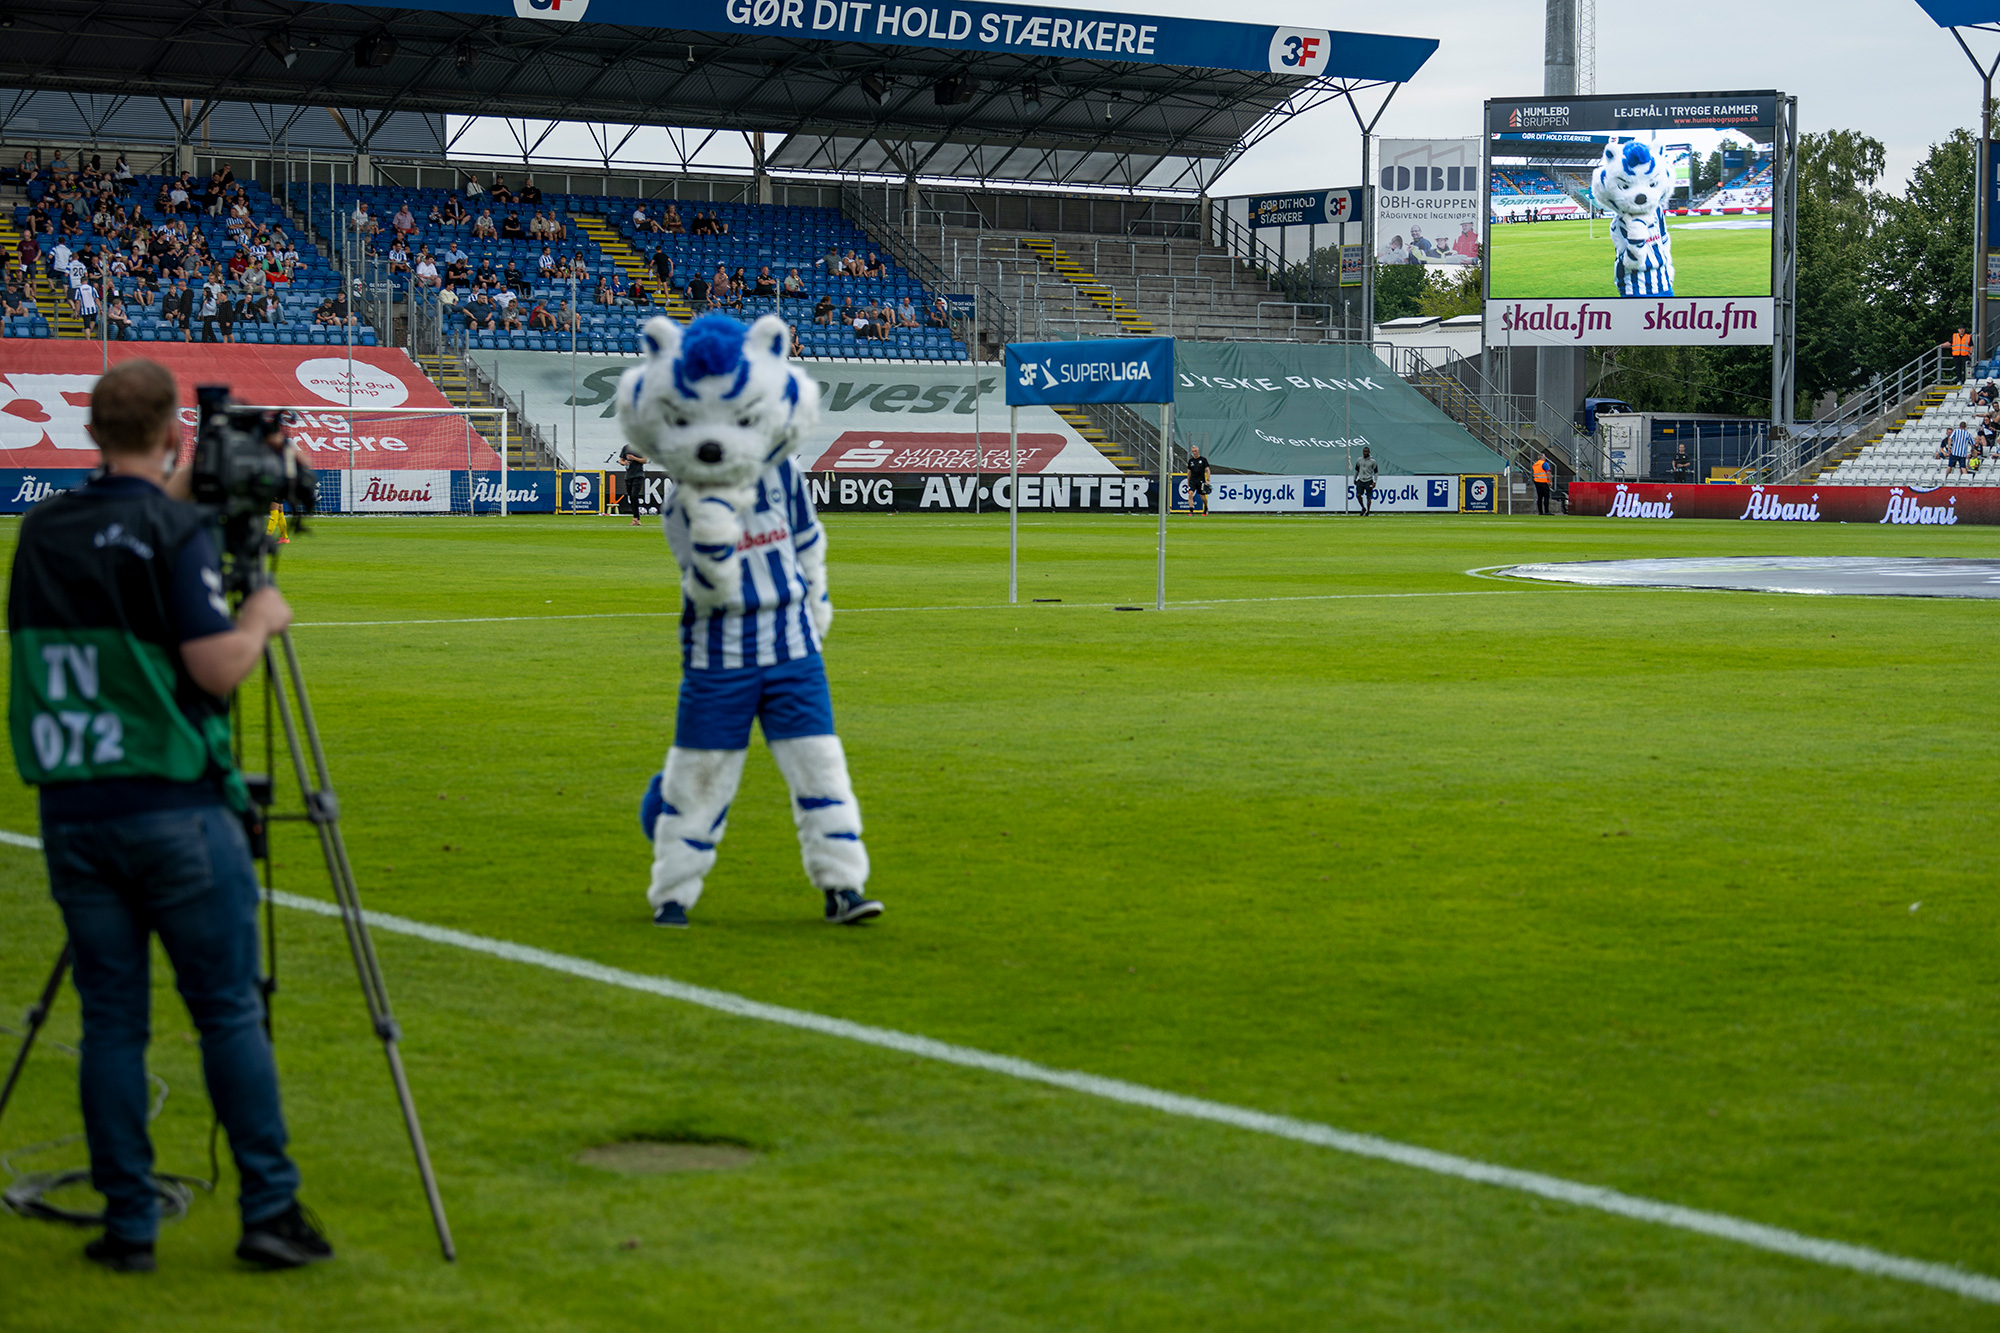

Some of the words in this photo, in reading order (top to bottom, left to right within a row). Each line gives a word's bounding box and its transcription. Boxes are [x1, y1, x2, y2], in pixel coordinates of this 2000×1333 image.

[725, 0, 803, 28] GØR
[812, 1, 870, 32] DIT
[876, 5, 972, 40] HOLD
[979, 13, 1158, 55] STÆRKERE
[1281, 36, 1320, 67] 3F
[1523, 106, 1570, 117] HUMLEBO
[1614, 104, 1662, 117] LEJEMÅL
[1670, 105, 1711, 116] TRYGGE
[1713, 104, 1759, 115] RAMMER
[1673, 116, 1759, 124] www.humlebogruppen.dk
[1523, 117, 1570, 127] GRUPPEN
[1329, 197, 1347, 216] 3F
[1380, 195, 1477, 209] OBH-GRUPPEN
[72, 267, 84, 277] 20
[1500, 303, 1612, 339] skala.fm
[1643, 302, 1757, 339] skala.fm
[1019, 362, 1037, 387] 3F
[1060, 361, 1151, 383] SUPERLIGA
[1179, 372, 1283, 392] JYSKE
[1285, 375, 1385, 391] BANK
[1255, 428, 1285, 445] Gør
[1288, 437, 1311, 448] en
[1310, 435, 1370, 448] forskel
[840, 478, 894, 506] BYG
[1219, 484, 1295, 504] 5e-byg.dk
[41, 644, 99, 700] TV
[31, 710, 125, 771] 072
